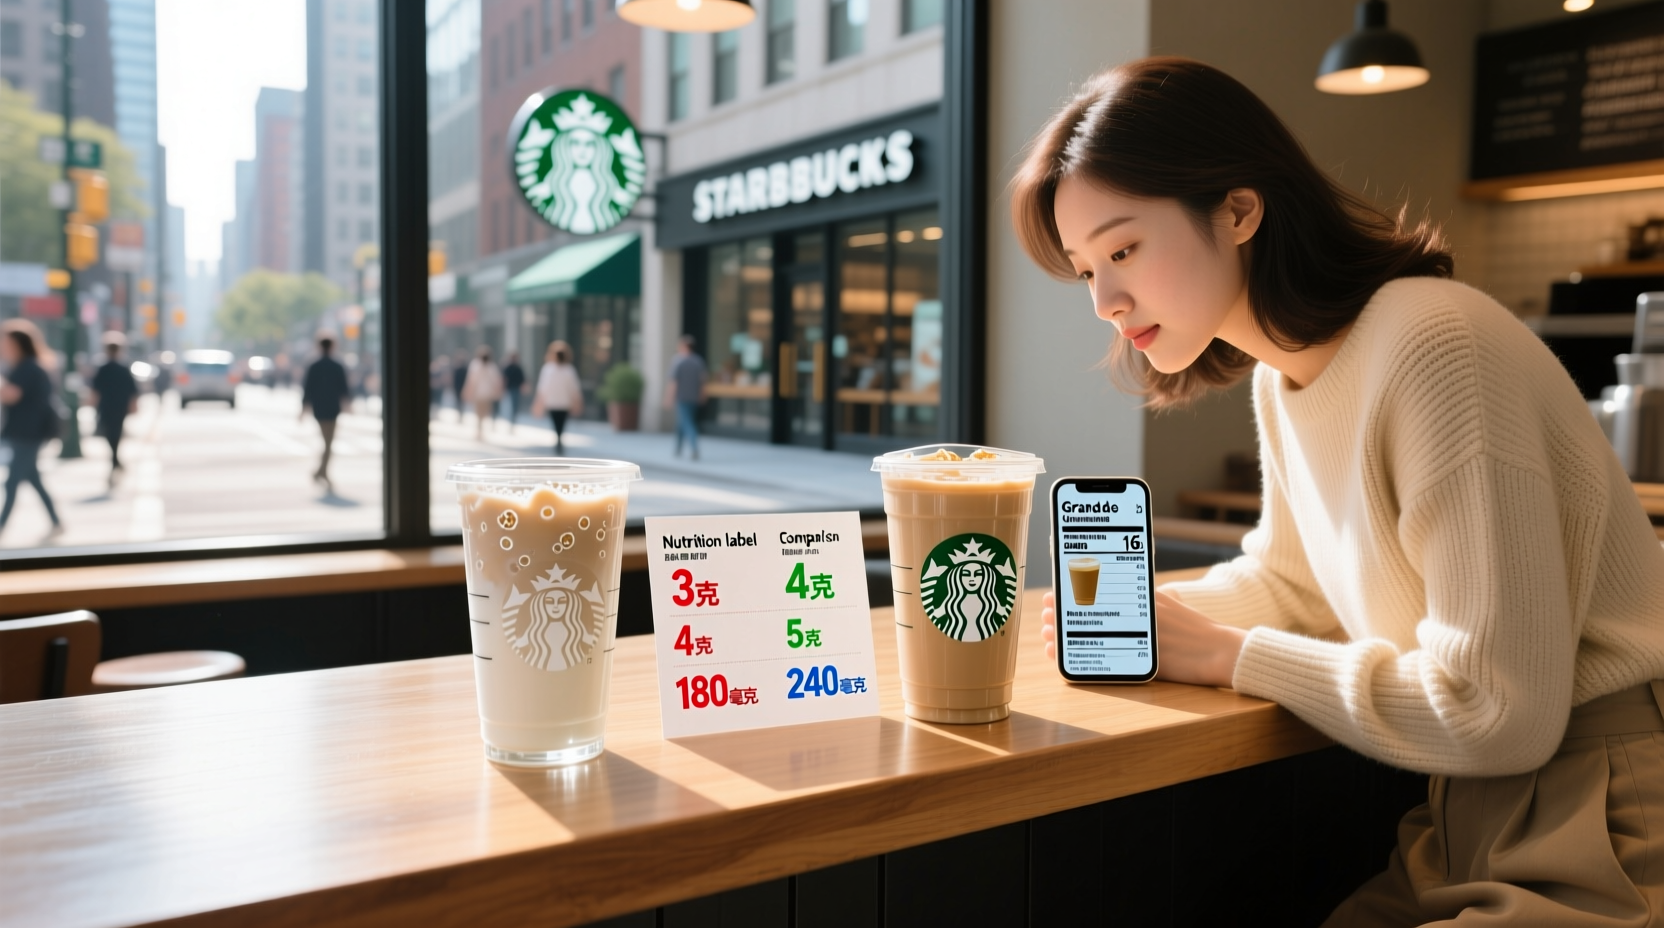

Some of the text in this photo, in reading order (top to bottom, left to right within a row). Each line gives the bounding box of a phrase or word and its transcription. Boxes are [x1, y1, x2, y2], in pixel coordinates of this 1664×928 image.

[692, 129, 914, 223] STARBBUCKS
[662, 531, 758, 549] Nutrition label
[671, 568, 720, 607] 3克
[785, 562, 835, 600] 4克
[674, 625, 714, 656] 4克
[786, 618, 822, 649] 5克
